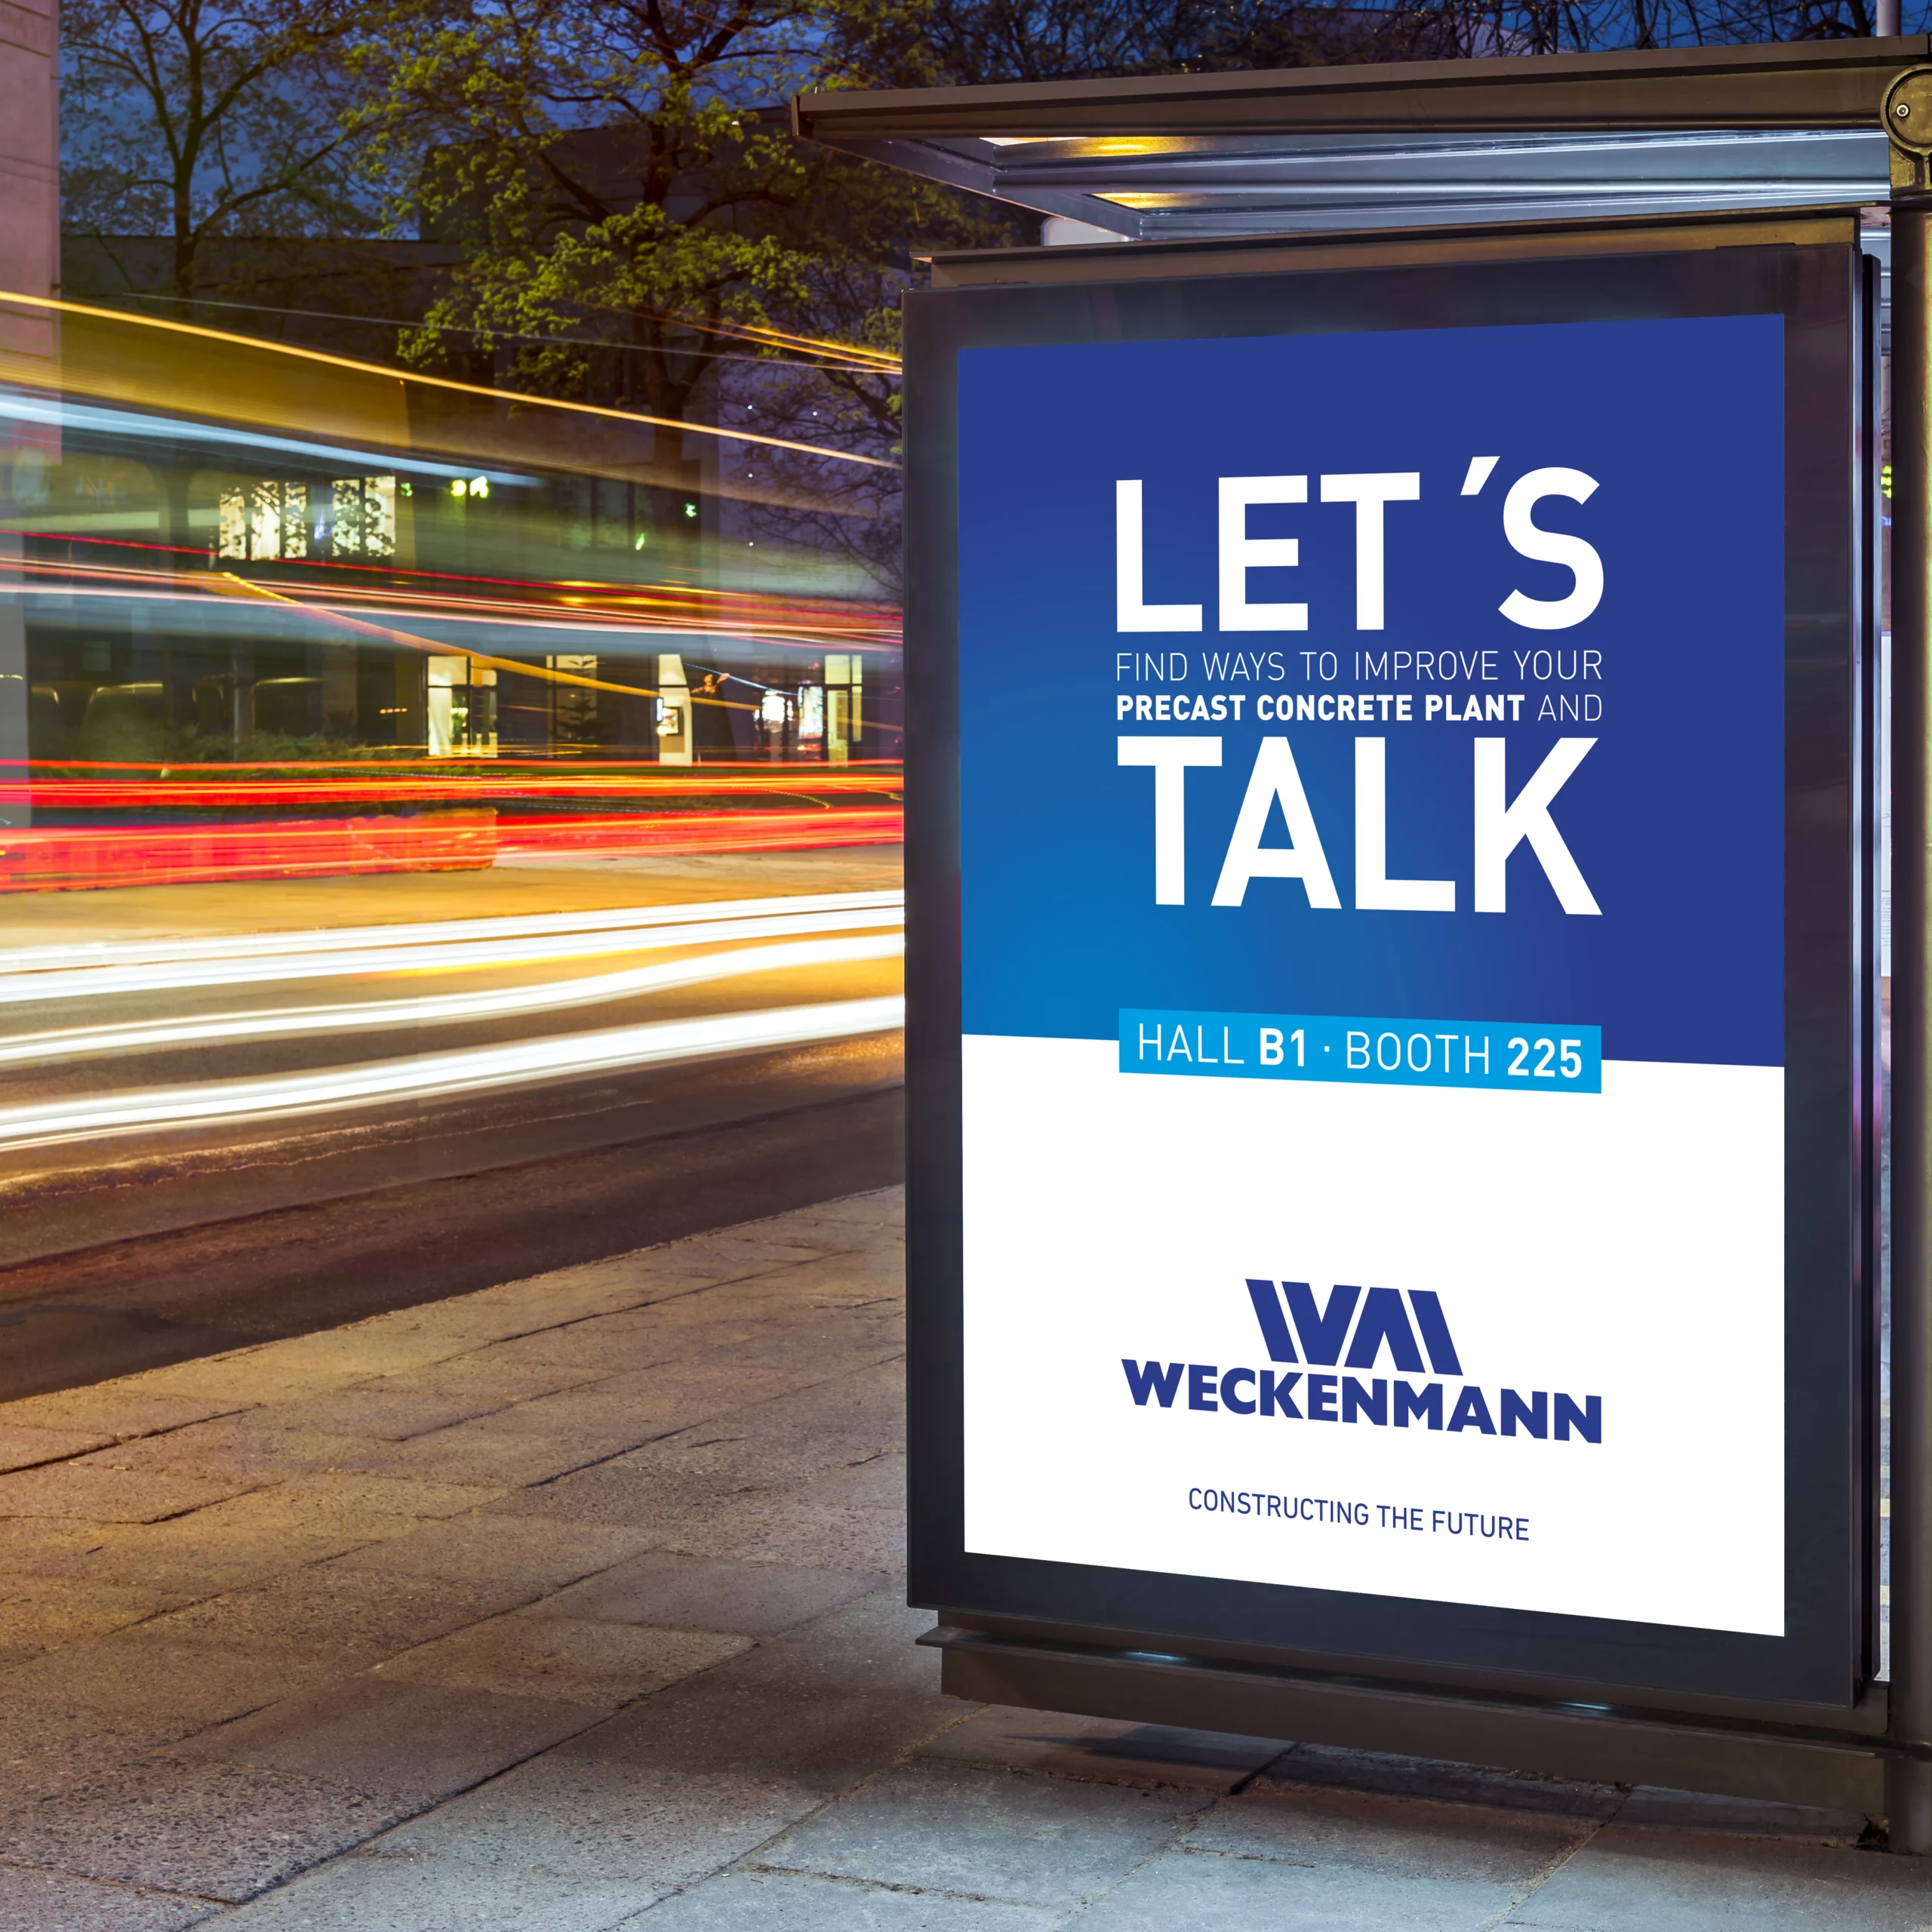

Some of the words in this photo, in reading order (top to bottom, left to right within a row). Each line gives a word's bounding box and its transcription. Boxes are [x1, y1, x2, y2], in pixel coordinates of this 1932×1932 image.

[1117, 653, 1187, 681] FIND
[1202, 652, 1285, 681] WAYS
[1300, 651, 1337, 681] TO
[1355, 651, 1499, 681] IMPROVE
[1513, 650, 1602, 680] YOUR
[1117, 694, 1246, 721] PRECAST
[1257, 694, 1413, 721] CONCRETE
[1425, 694, 1525, 721] PLANT
[1537, 694, 1602, 721] AND
[1117, 736, 1603, 915] TALK
[1138, 1023, 1244, 1064] HALL
[1260, 1028, 1306, 1066] B1
[1346, 1031, 1490, 1074] BOOTH
[1507, 1037, 1583, 1078] 225
[1121, 1359, 1602, 1444] WECKENMANN
[1189, 1487, 1369, 1526] CONSTRUCTING
[1376, 1505, 1423, 1531] THE
[1432, 1510, 1530, 1541] FUTURE
